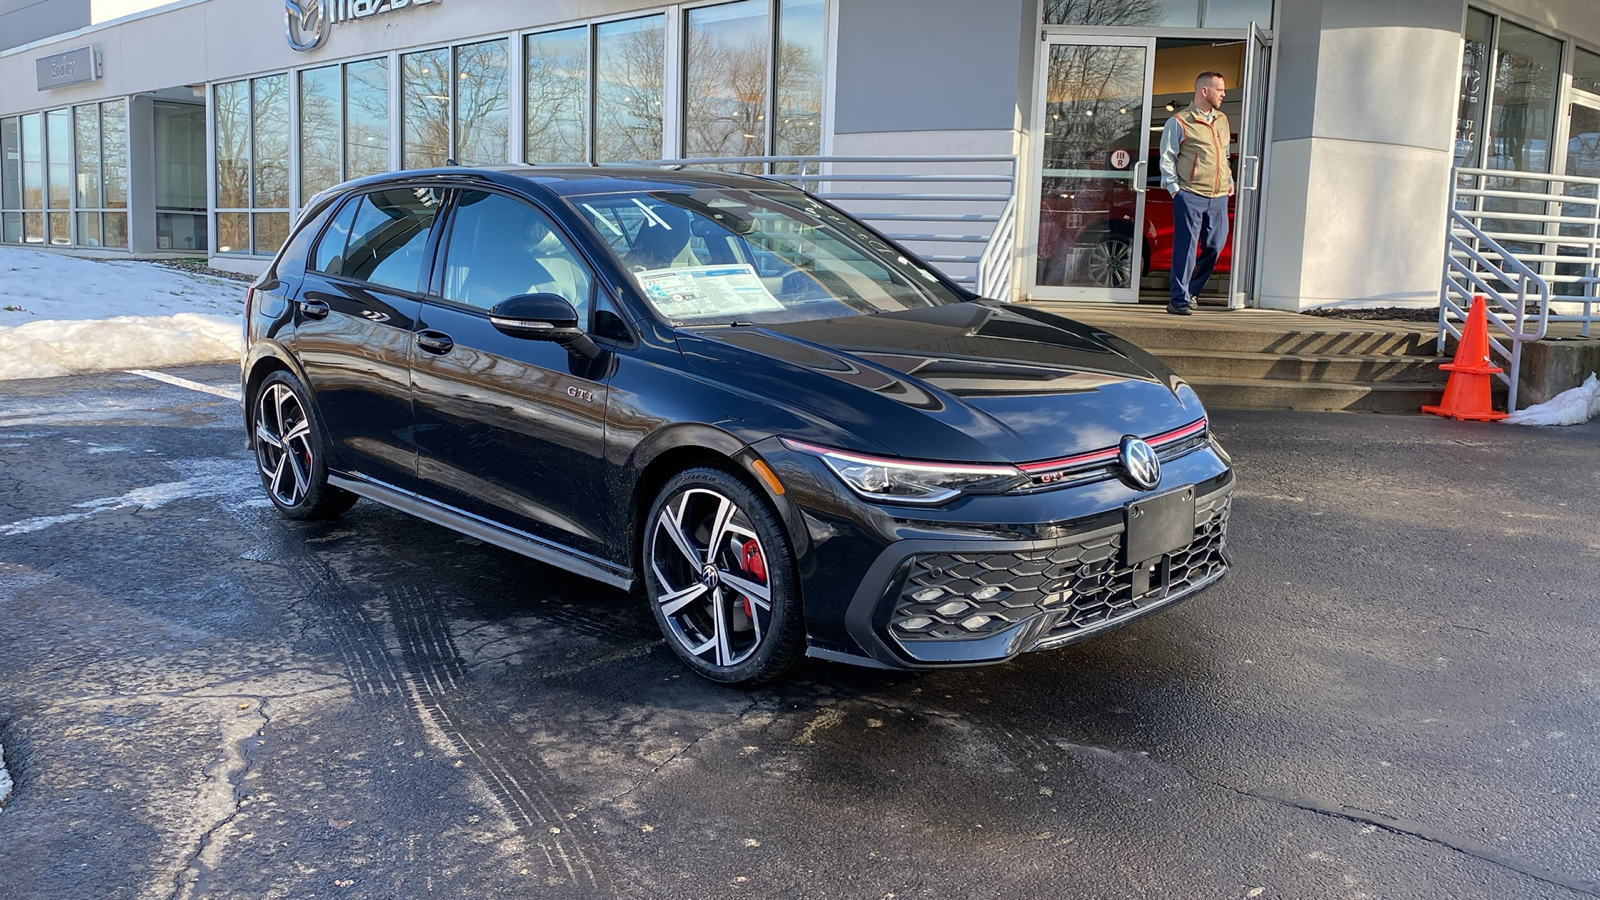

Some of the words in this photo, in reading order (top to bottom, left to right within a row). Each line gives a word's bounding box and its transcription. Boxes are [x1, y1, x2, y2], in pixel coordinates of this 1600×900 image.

[329, 0, 442, 23] maz
[567, 386, 594, 402] GTI
[1041, 471, 1064, 483] GTI
